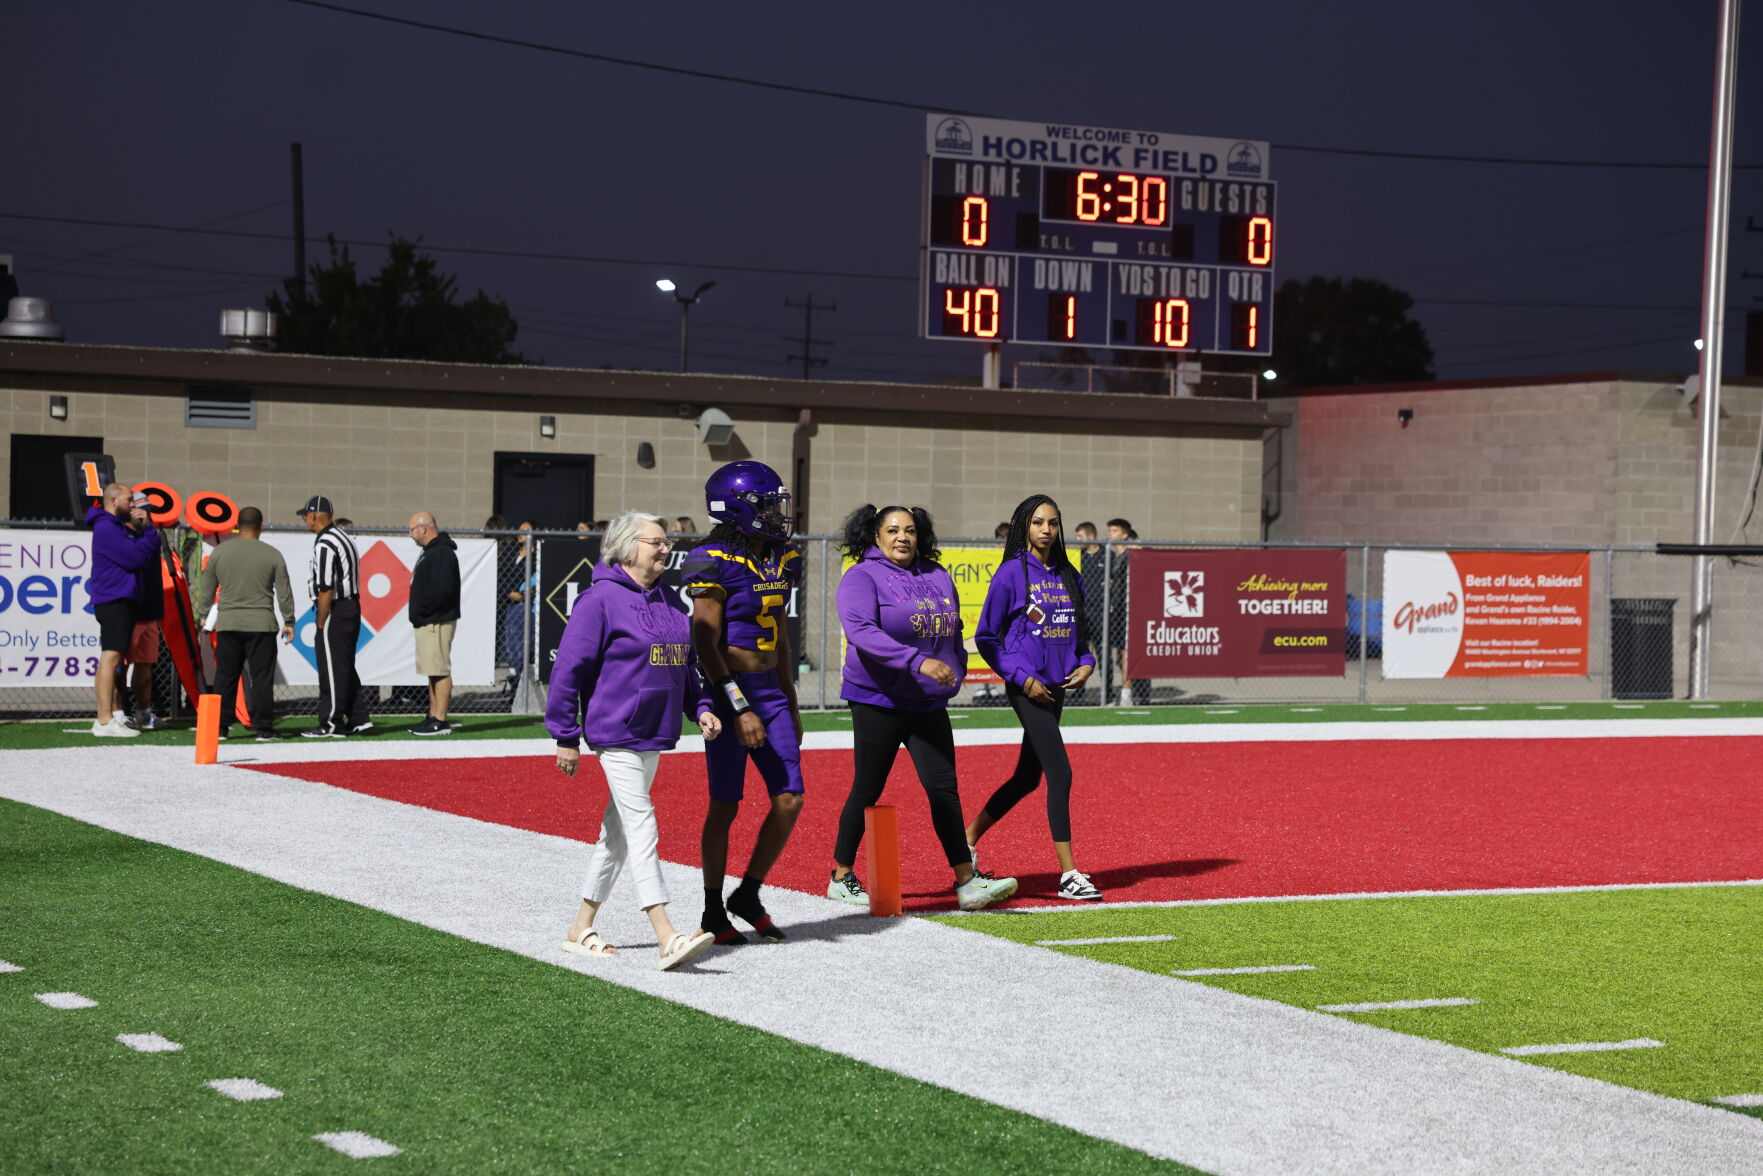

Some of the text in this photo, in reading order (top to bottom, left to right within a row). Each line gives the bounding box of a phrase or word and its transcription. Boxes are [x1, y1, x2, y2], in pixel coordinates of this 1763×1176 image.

[1046, 125, 1159, 146] WELCOME TO
[983, 135, 1122, 167] HORLICK
[1134, 148, 1218, 174] FIELD
[955, 162, 1021, 197] HOME
[1076, 171, 1166, 225] 6:30
[1181, 180, 1267, 215] GUESTS
[963, 196, 988, 247] 0
[1248, 217, 1272, 265] 0
[935, 252, 1009, 287] BALL ON
[1034, 259, 1092, 292] DOWN
[1119, 264, 1210, 299] YDS TO GO
[1228, 271, 1263, 302] QTR
[946, 288, 999, 338] 40
[1067, 296, 1075, 338] 1
[1155, 299, 1189, 347] 10
[1249, 306, 1257, 348] 1
[81, 461, 103, 496] 1
[752, 581, 789, 592] CRUSADERS
[1236, 574, 1328, 600] Achieving more
[1465, 574, 1583, 588] Best of luck, Raiders!
[756, 594, 784, 651] 5
[1238, 599, 1328, 614] TOGETHER!
[0, 630, 39, 651] Only
[1042, 626, 1071, 638] Sister
[1146, 620, 1219, 644] Educators
[1273, 636, 1328, 646] ecu.com
[0, 656, 99, 676] -7783
[1146, 645, 1181, 656] CREDIT
